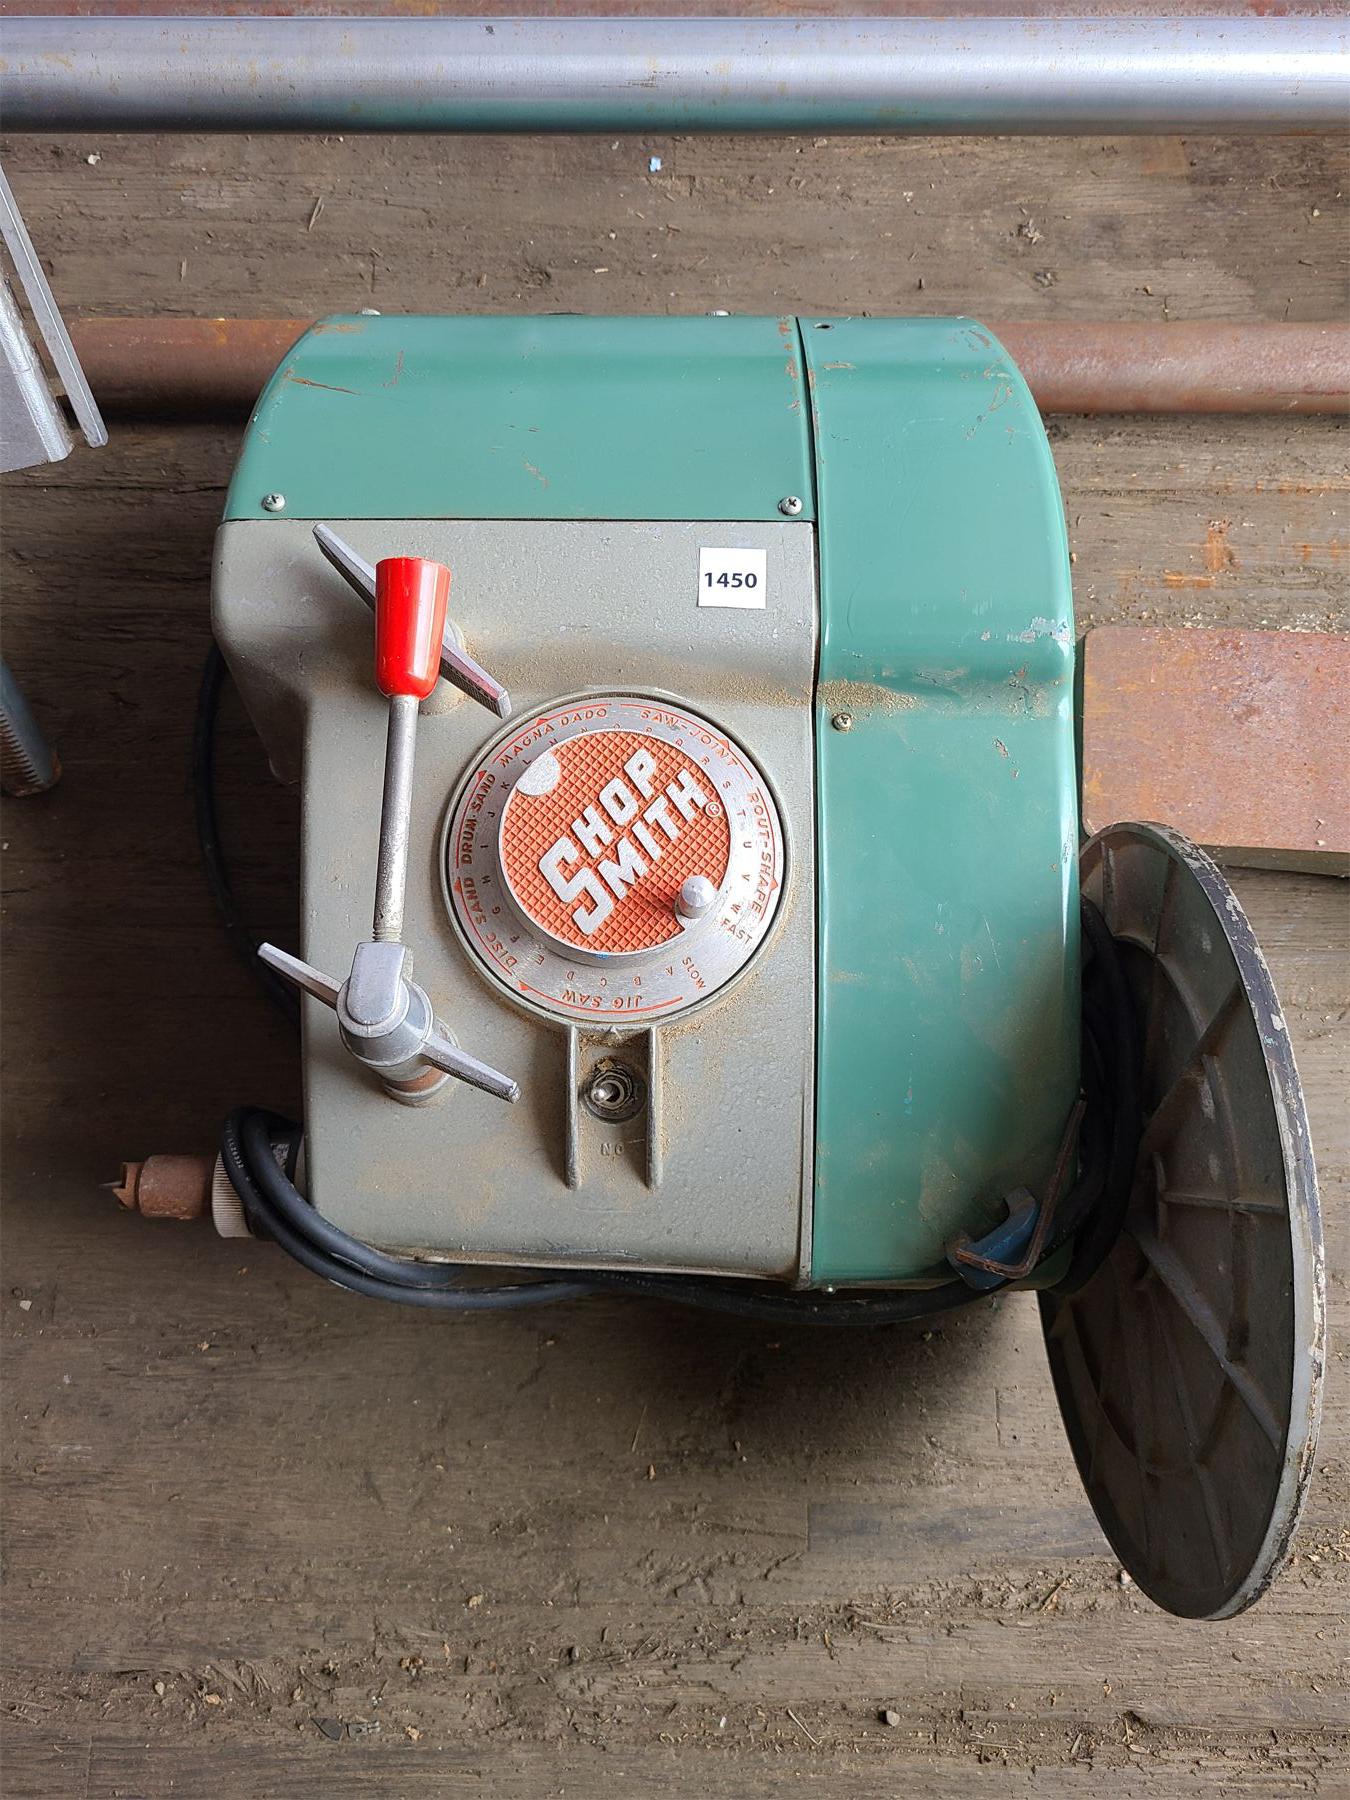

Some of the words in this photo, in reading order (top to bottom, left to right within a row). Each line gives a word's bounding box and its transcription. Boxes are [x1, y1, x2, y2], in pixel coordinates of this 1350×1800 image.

[704, 572, 758, 588] 1450
[500, 723, 555, 768] MAGNA
[559, 708, 608, 727] DADO
[701, 756, 710, 766] R
[501, 781, 510, 790] K
[723, 780, 731, 789] S
[737, 809, 746, 817] T
[461, 818, 478, 865] DRUM
[471, 773, 496, 812] SAND
[743, 841, 752, 849] U
[481, 875, 491, 885] H
[742, 874, 750, 882] V
[463, 877, 488, 925] SAND
[492, 906, 501, 915] G
[730, 903, 741, 914] W
[720, 917, 753, 945] FAST
[510, 934, 520, 943] F
[485, 931, 518, 968] DISC
[534, 954, 545, 965] E
[566, 970, 575, 981] D
[665, 966, 674, 976] A
[682, 956, 707, 991] SLOW
[600, 977, 607, 987] C
[633, 976, 641, 986] B
[562, 989, 603, 1009] SAW
[612, 995, 643, 1009] JIG
